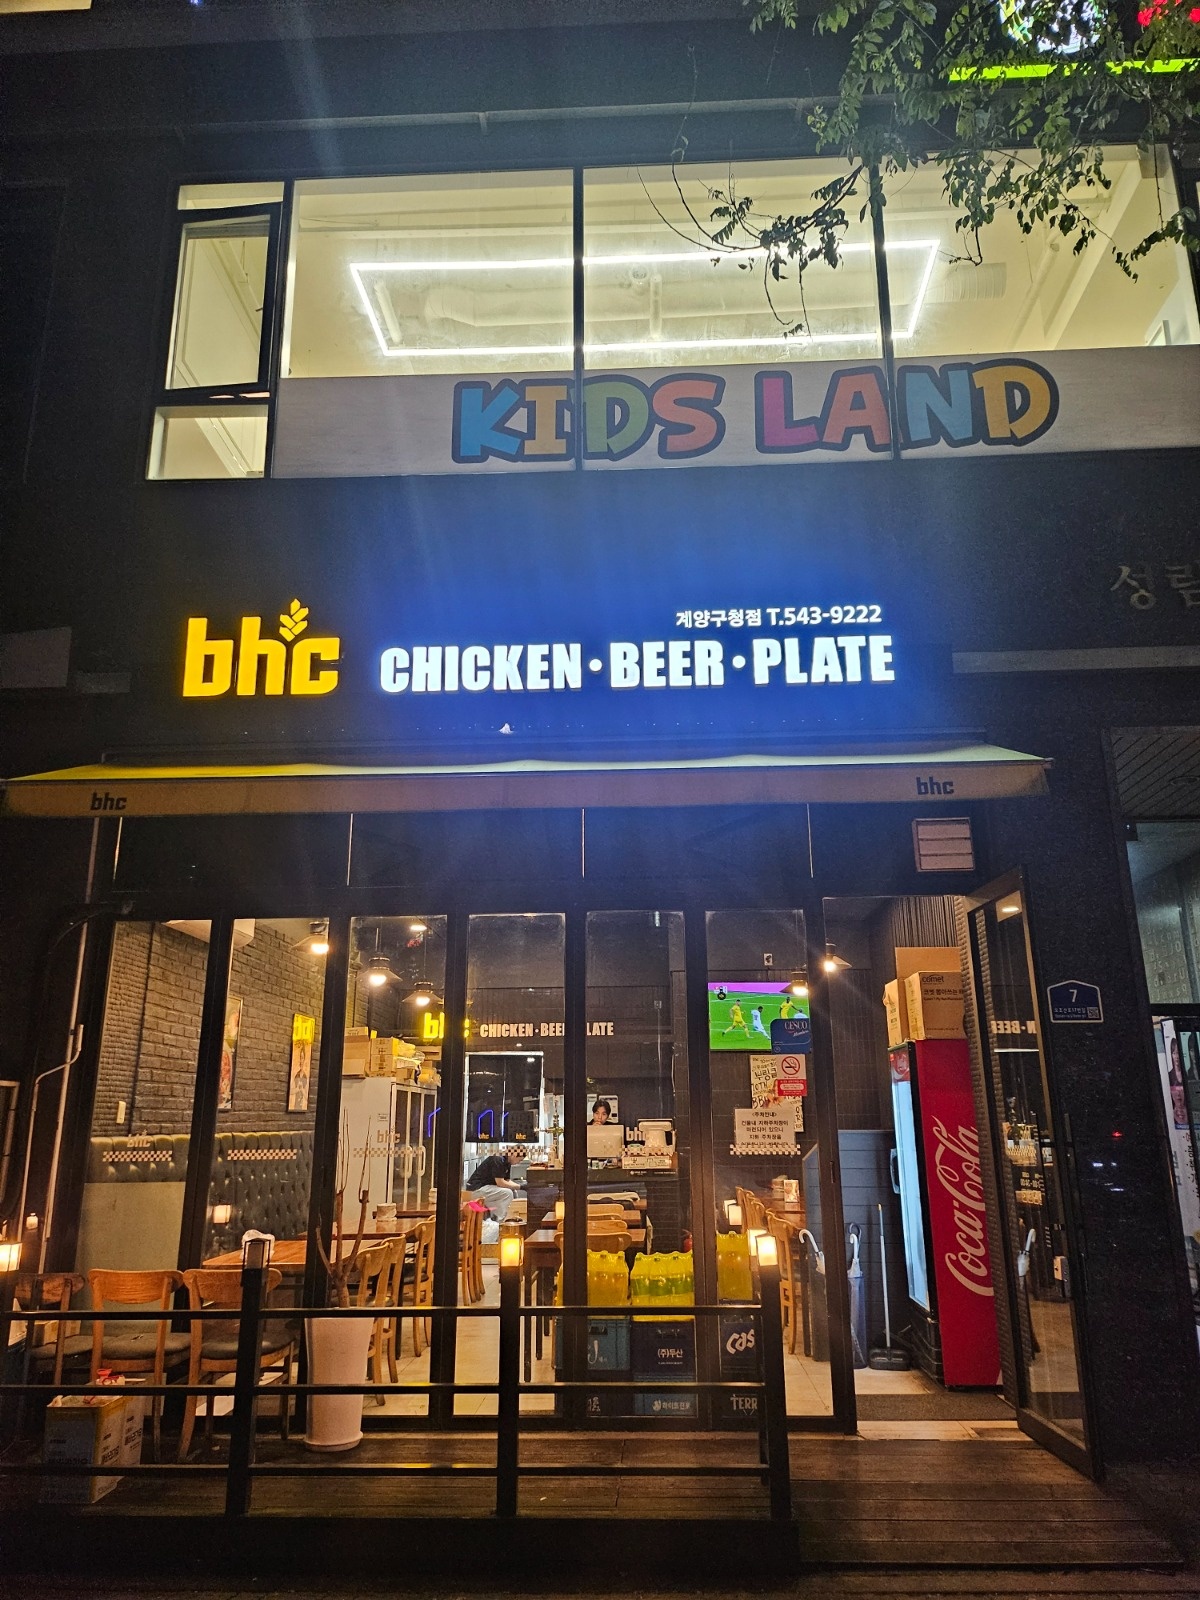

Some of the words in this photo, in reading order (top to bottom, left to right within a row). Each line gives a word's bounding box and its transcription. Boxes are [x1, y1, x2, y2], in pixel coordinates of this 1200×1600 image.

[451, 373, 726, 464] KIDS
[755, 359, 1059, 455] LAND
[676, 607, 762, 629] 계양구청점
[766, 605, 882, 627] T.543-9222
[182, 612, 341, 698] bhc
[379, 643, 583, 693] CHICKEN
[610, 641, 725, 689] BEER
[753, 634, 896, 686] PLATE
[917, 777, 955, 796] bhc
[90, 792, 127, 811] bhc
[922, 974, 945, 983] comet
[1069, 989, 1078, 1003] 7
[480, 1023, 534, 1038] CHICKEN
[586, 1021, 614, 1036] LATE
[657, 1348, 684, 1359] (주)두산
